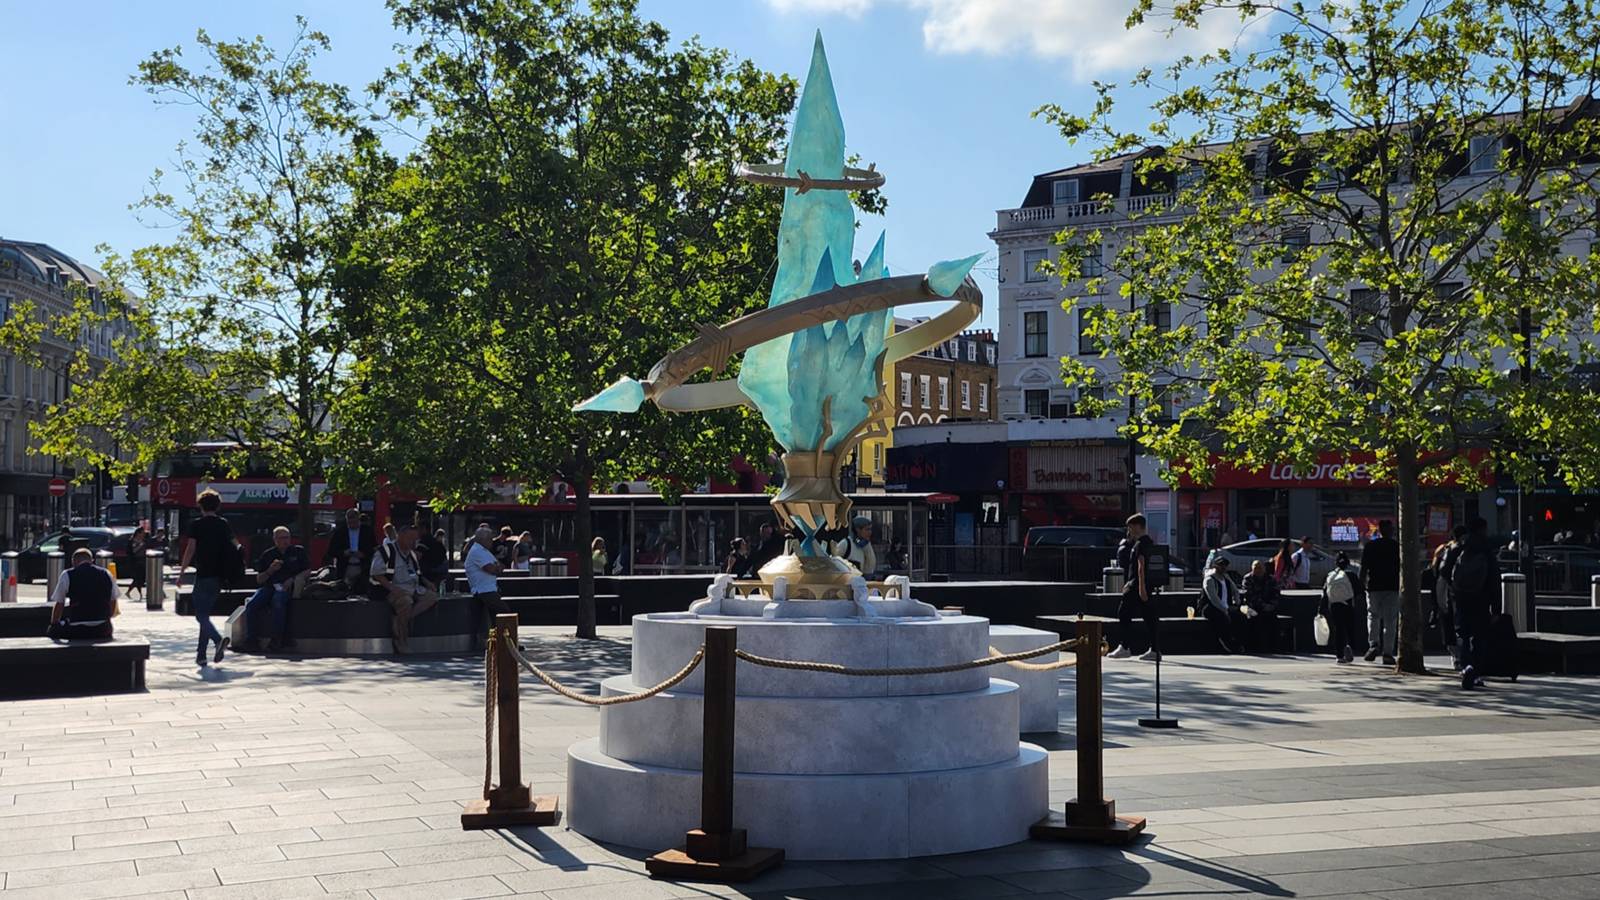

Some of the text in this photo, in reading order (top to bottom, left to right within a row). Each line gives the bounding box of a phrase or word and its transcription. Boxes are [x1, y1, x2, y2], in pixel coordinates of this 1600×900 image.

[1033, 467, 1091, 483] Bamboo
[1097, 468, 1124, 483] Inn
[1269, 459, 1376, 481] Labroe
